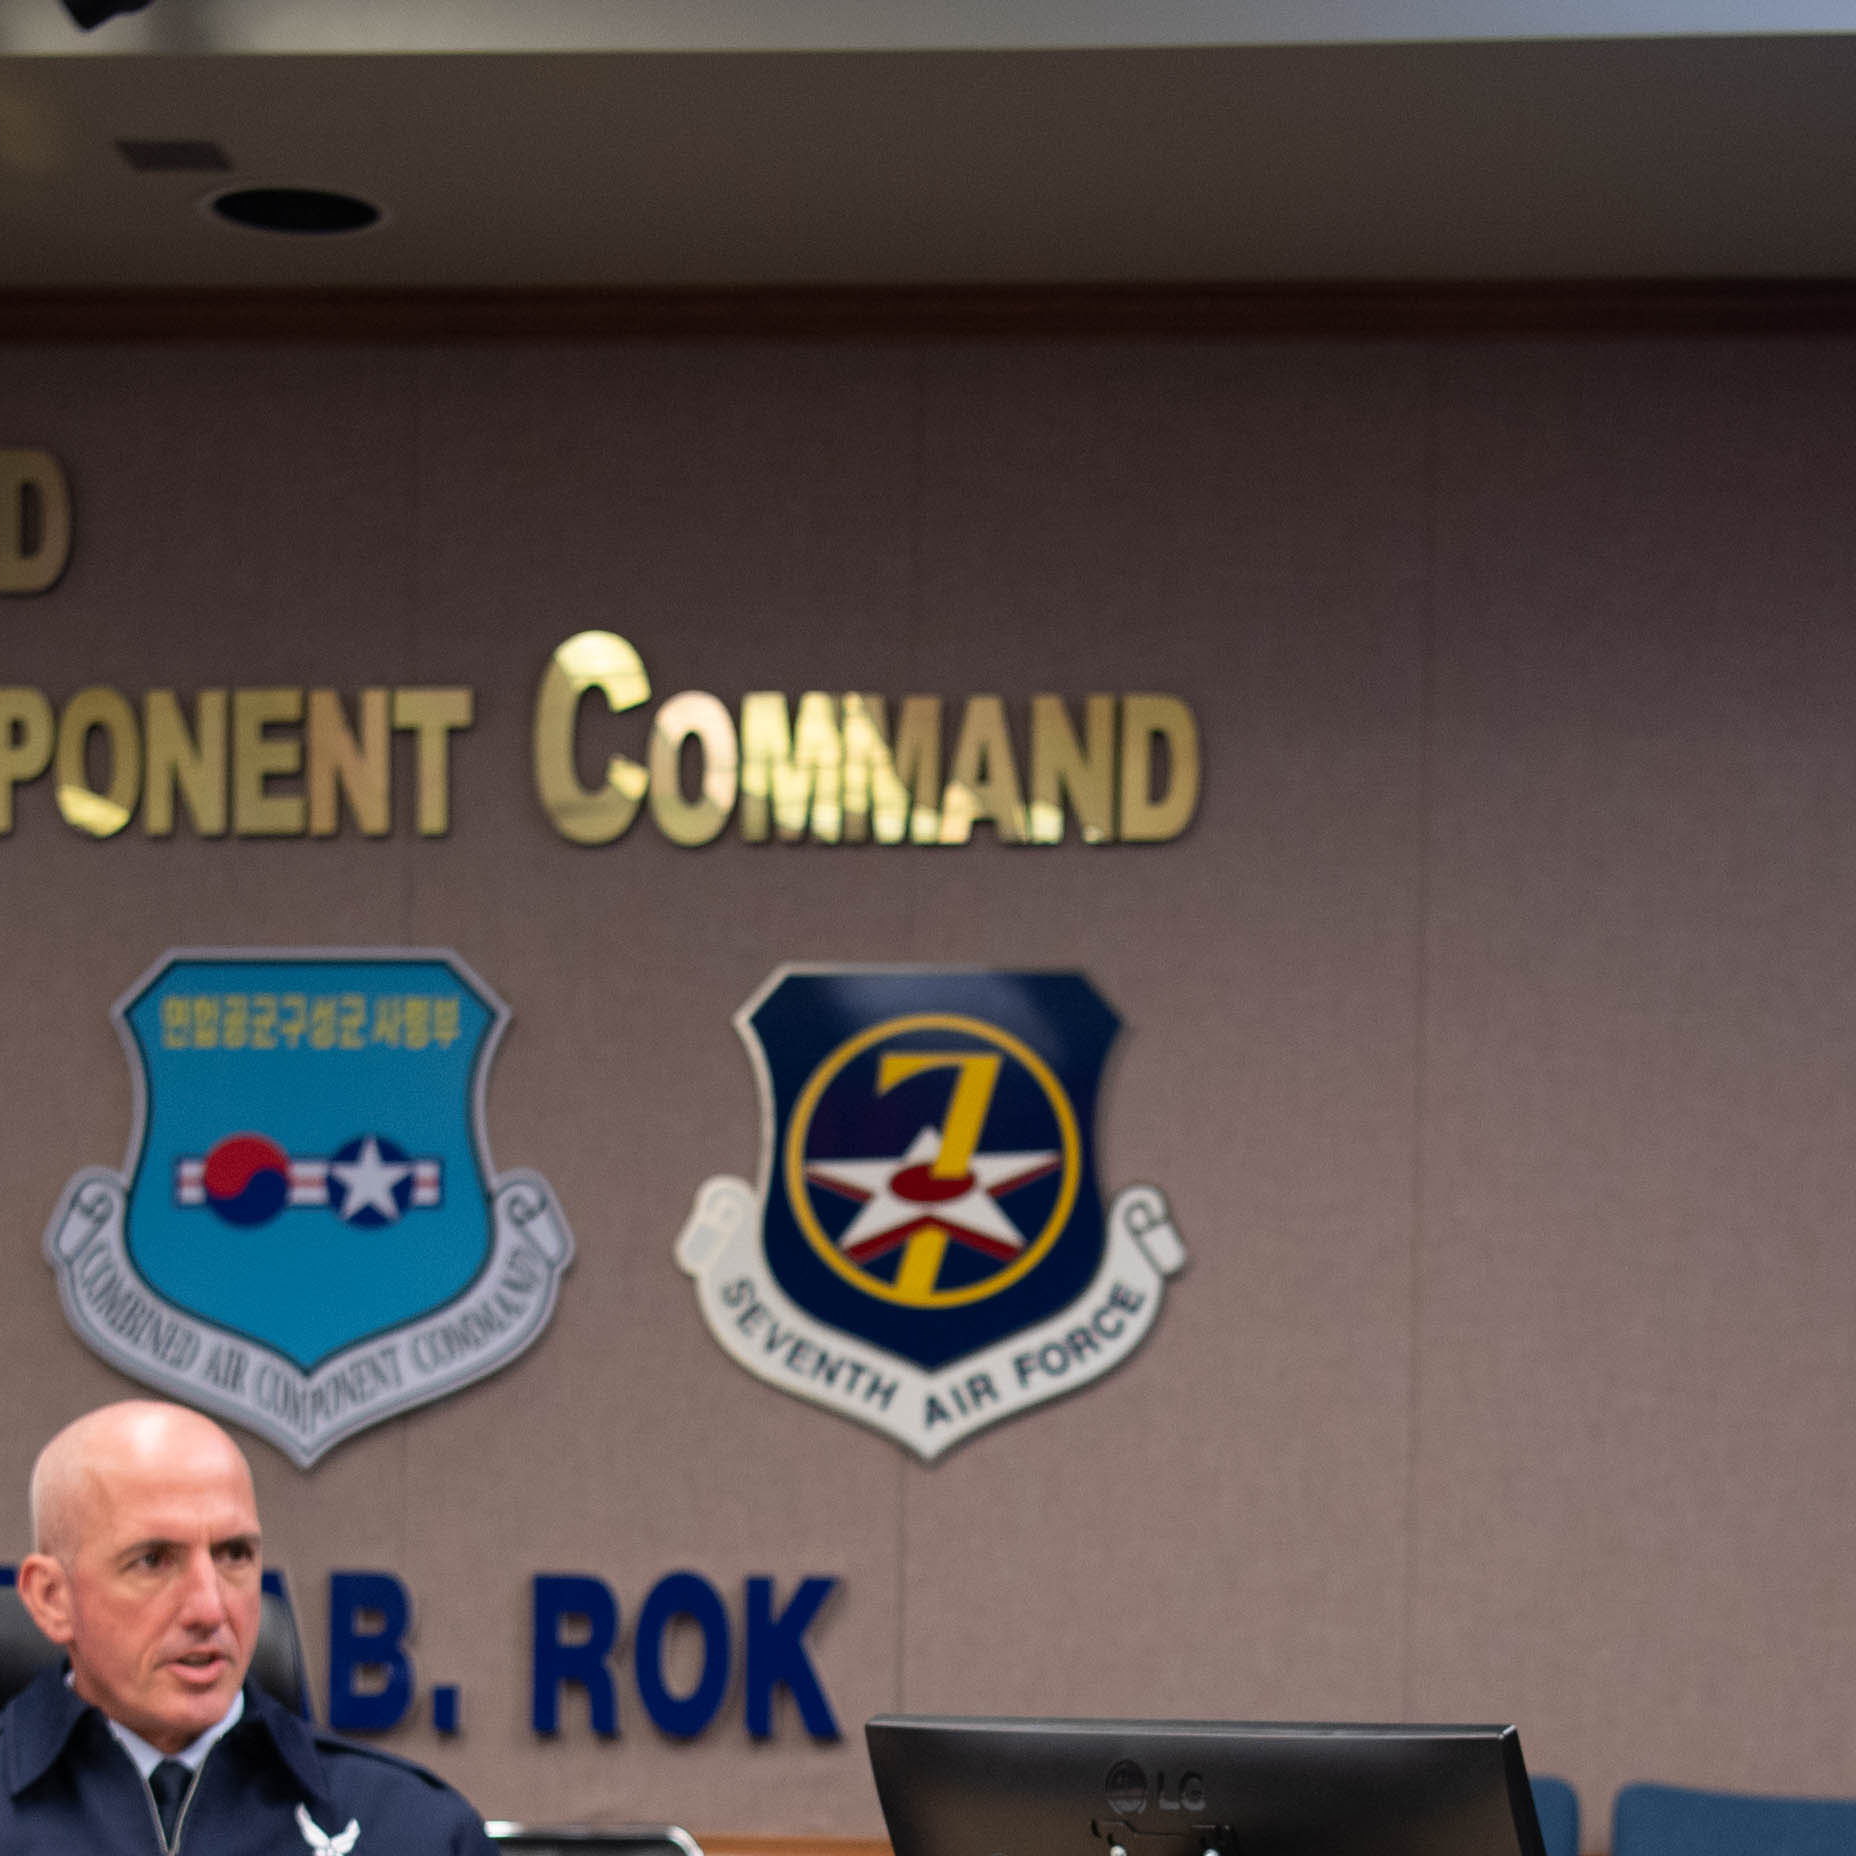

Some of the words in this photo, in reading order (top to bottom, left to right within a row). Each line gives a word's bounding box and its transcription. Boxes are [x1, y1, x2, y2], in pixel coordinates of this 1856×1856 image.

[536, 628, 1201, 842] COMMAND
[876, 1053, 1003, 1298] 7
[81, 1240, 201, 1371] COMBINED
[204, 1345, 247, 1392] AIR
[723, 1278, 898, 1411] SEVENTH
[923, 1372, 998, 1429] AIR
[1013, 1281, 1145, 1389] FORCE
[531, 1568, 842, 1742] ROK
